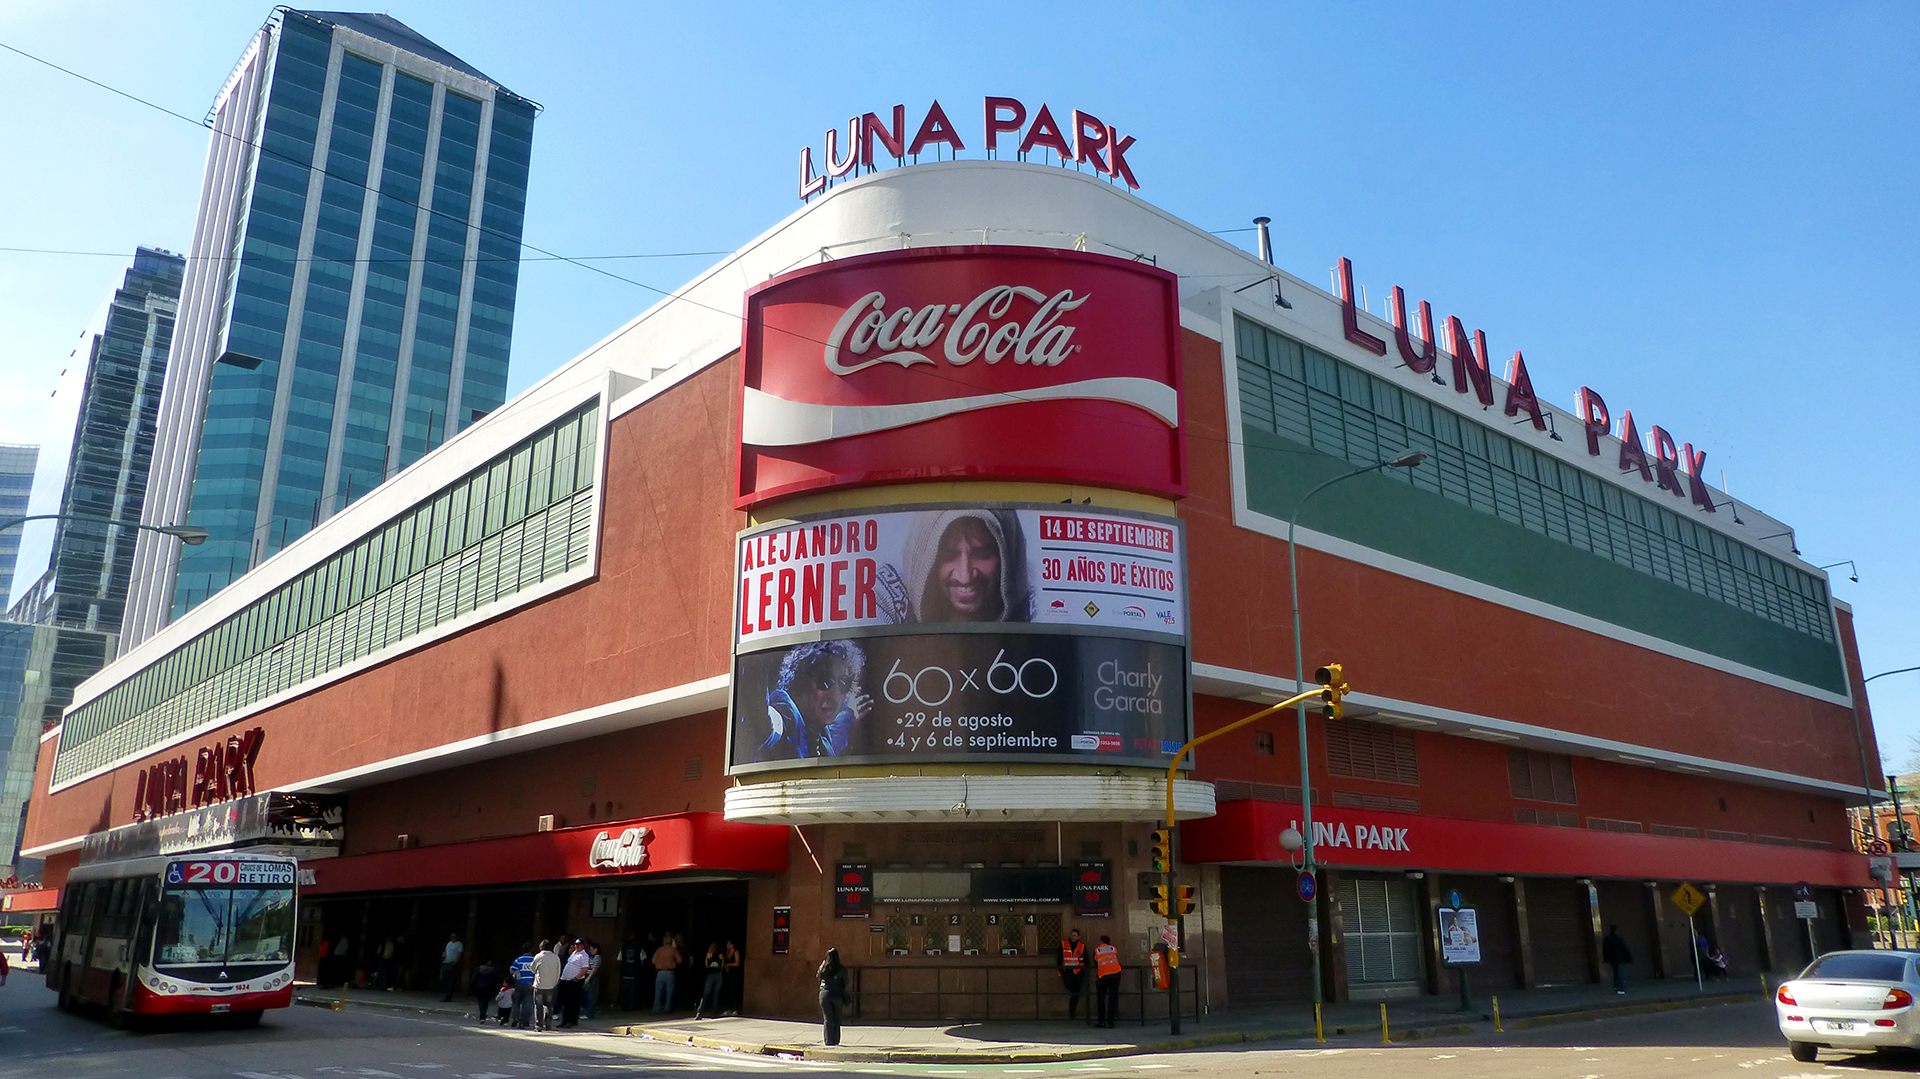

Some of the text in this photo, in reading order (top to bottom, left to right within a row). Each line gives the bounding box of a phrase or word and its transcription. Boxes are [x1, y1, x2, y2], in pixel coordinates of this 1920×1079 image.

[800, 96, 1140, 200] LUNA PARK
[824, 285, 1091, 375] Coca-Cola
[1338, 256, 1716, 513] LUNA PARK
[744, 519, 878, 572] ALEJANDRO
[1045, 519, 1169, 549] 14 DE SEPTIEMBRE
[1042, 556, 1174, 592] 30 AÑOS DE ÉXITOS
[741, 558, 877, 635] LERNER
[883, 658, 953, 706] 60
[987, 648, 1058, 698] 60
[1097, 659, 1162, 696] Charly
[1094, 686, 1162, 714] García
[904, 711, 1013, 731] 29 de agosto
[911, 737, 920, 751] y
[926, 732, 937, 746] 6
[943, 731, 963, 747] de
[969, 730, 1058, 750] septiembre
[191, 727, 264, 806] PARK
[1355, 825, 1410, 851] PARK
[188, 862, 236, 883] 20
[264, 864, 292, 872] LOMAS
[239, 873, 291, 883] RETIRO
[602, 897, 607, 912] 1
[914, 916, 919, 924] 1
[952, 916, 958, 924] 2
[990, 916, 996, 924] 3
[1028, 916, 1034, 924] 4
